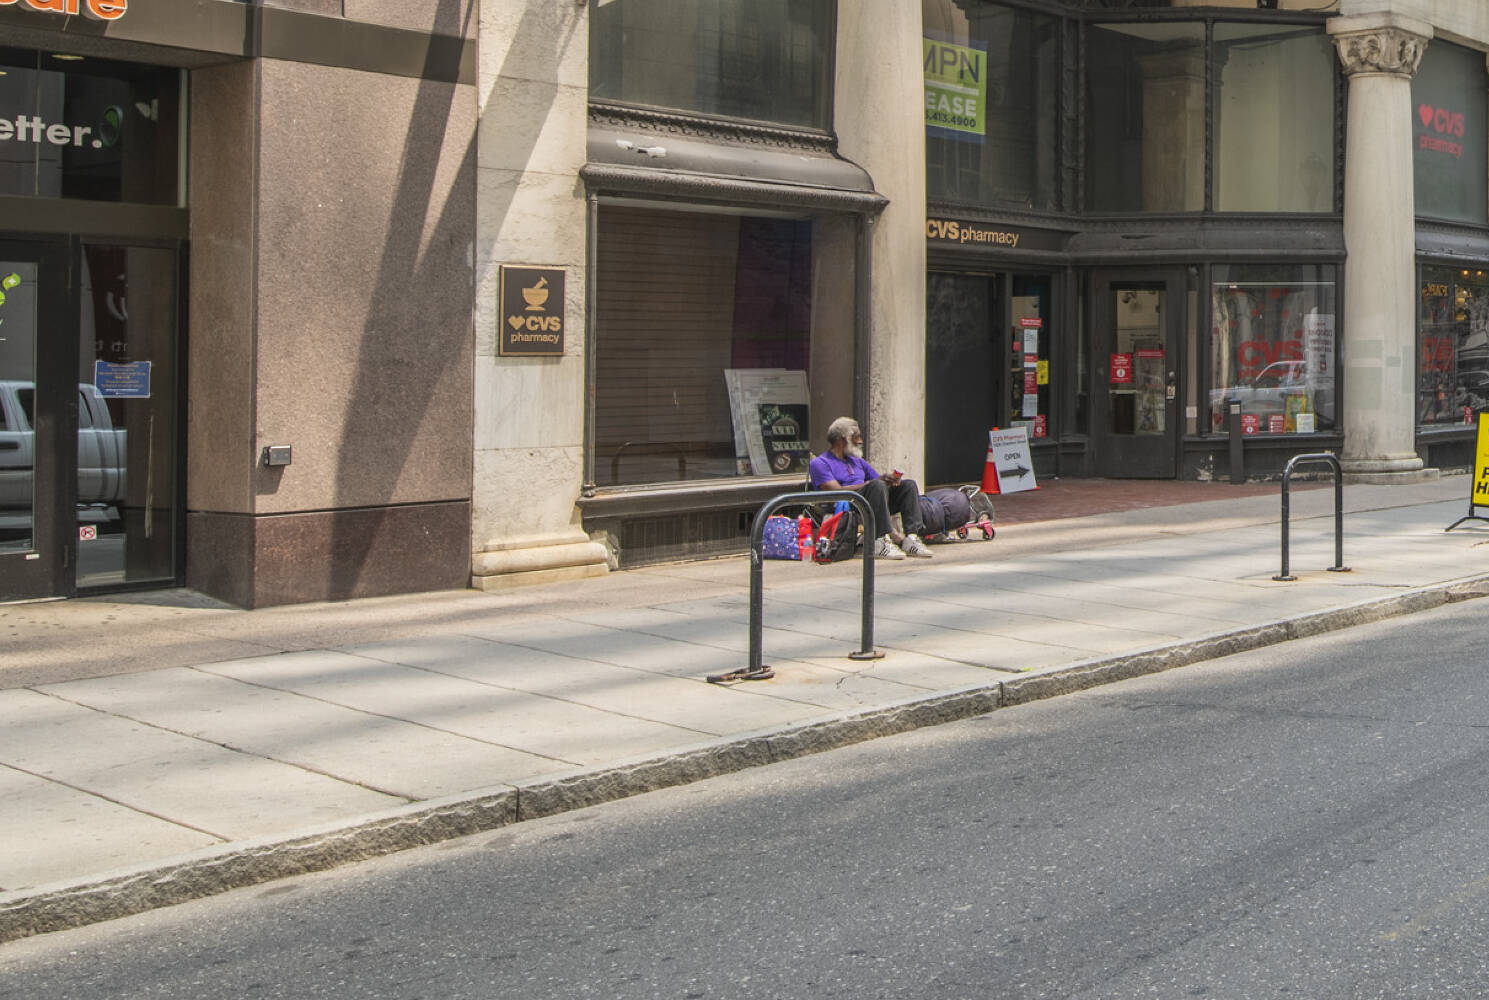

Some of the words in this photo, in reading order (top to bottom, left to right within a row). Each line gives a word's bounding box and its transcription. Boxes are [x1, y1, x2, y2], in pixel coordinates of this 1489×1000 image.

[926, 91, 977, 117] EASE
[1434, 108, 1464, 137] CVS
[925, 219, 959, 239] CVS
[961, 226, 1019, 248] pharmacy
[526, 315, 561, 331] CVS
[510, 333, 560, 345] pharmacy
[1237, 340, 1304, 367] CVS
[1003, 452, 1021, 460] OPEN
